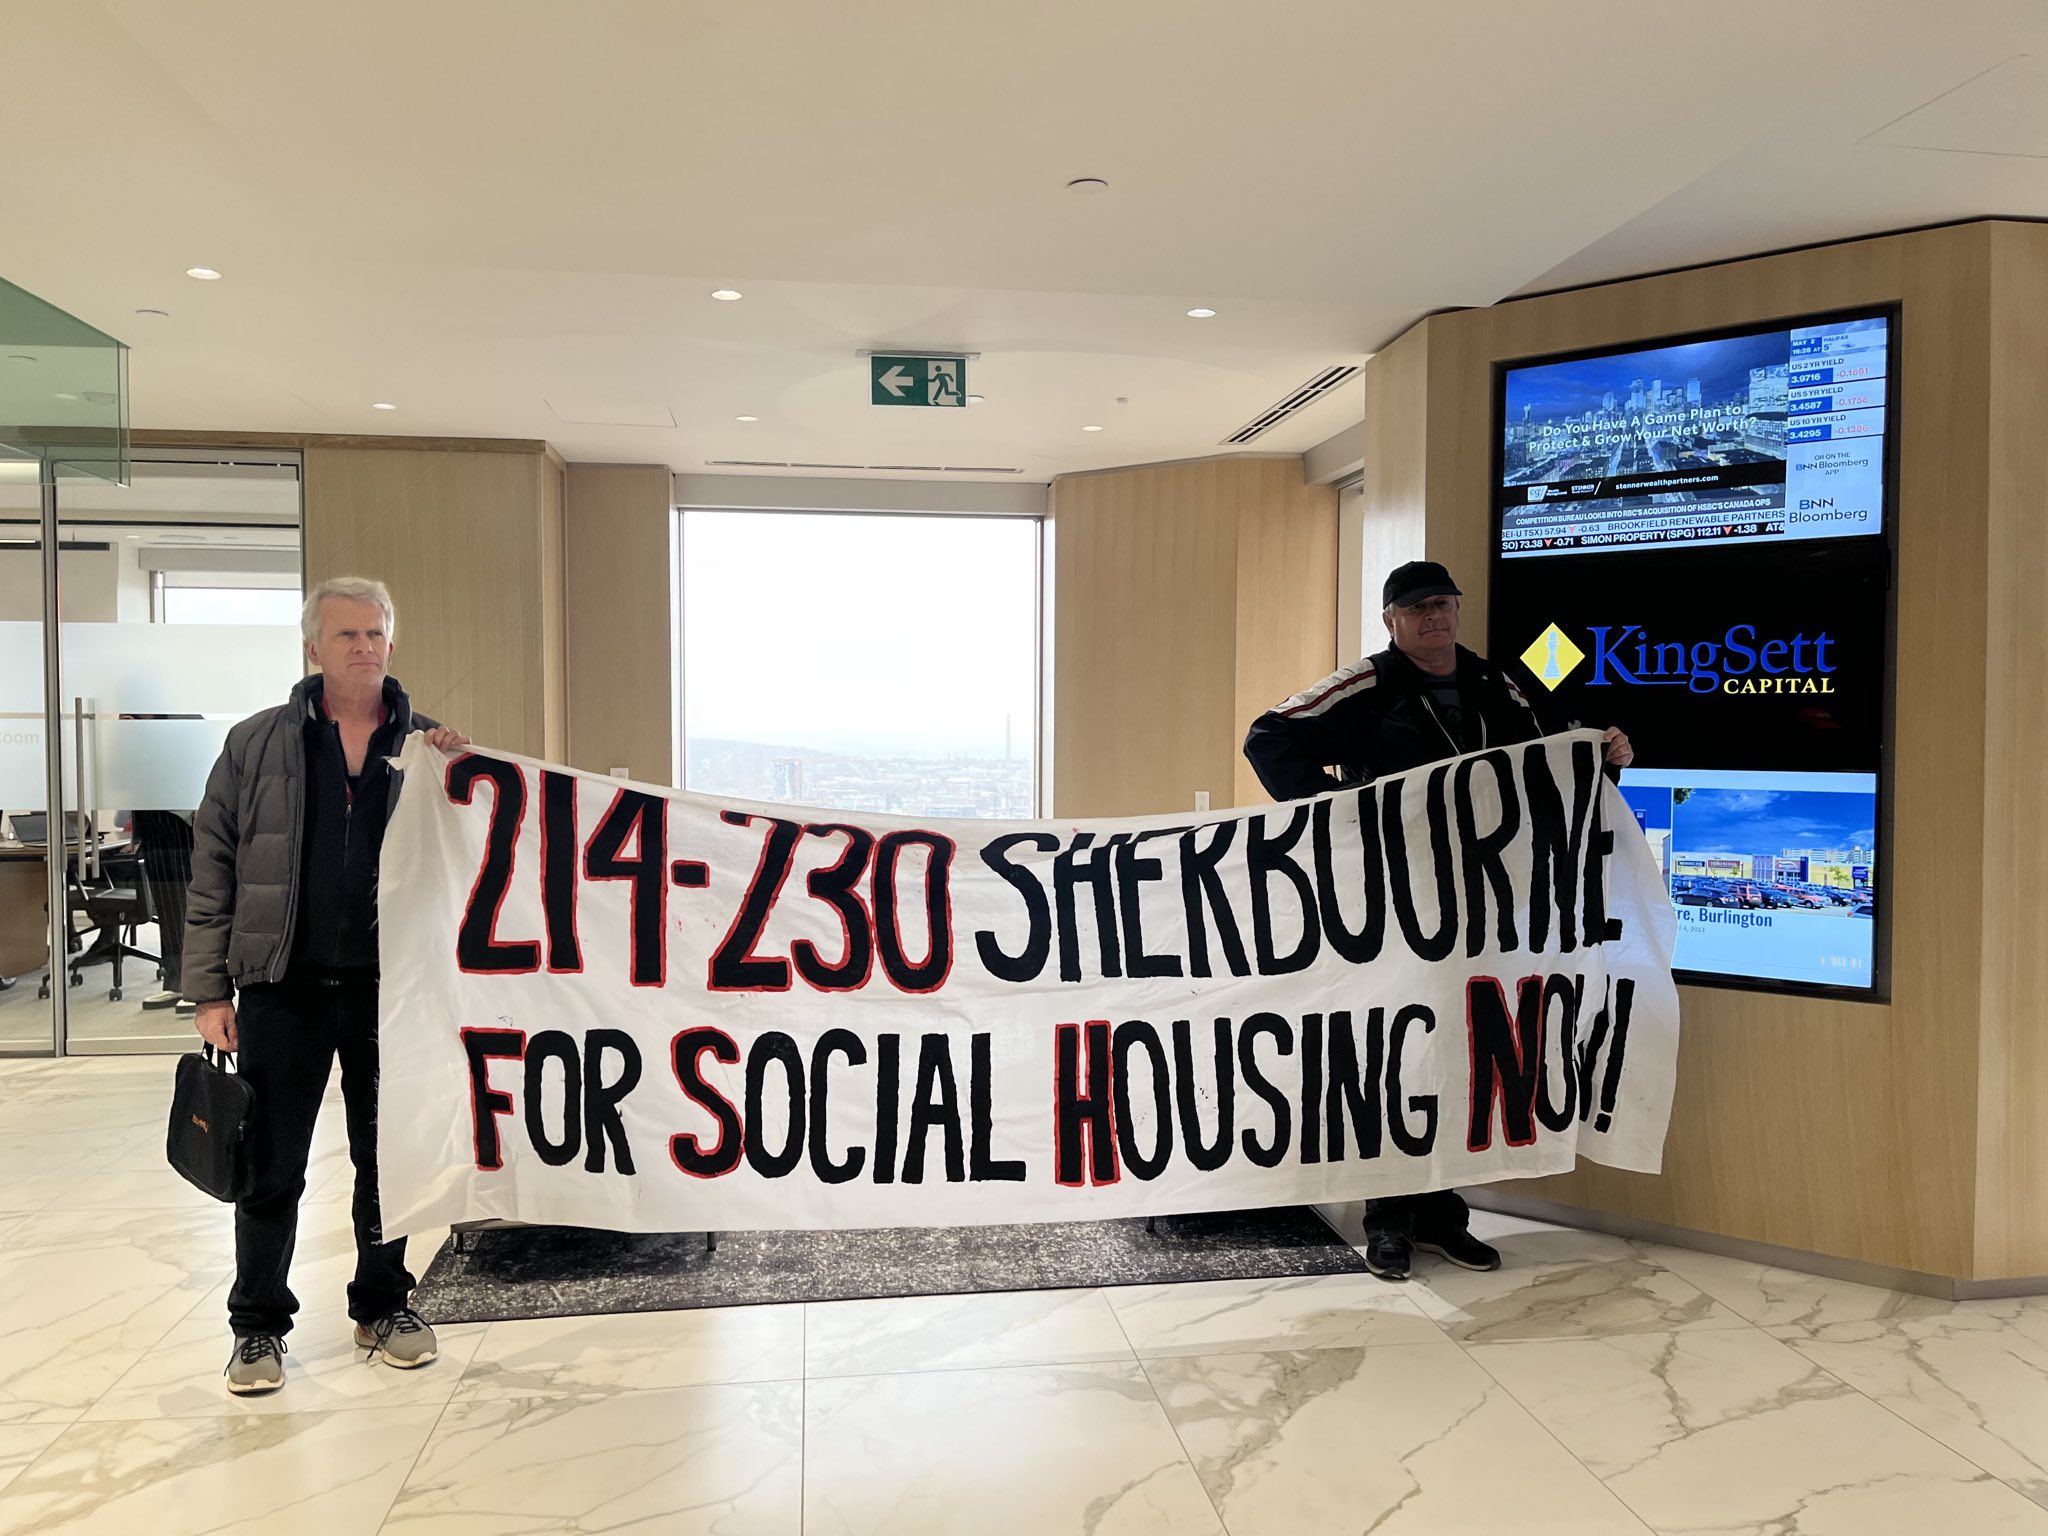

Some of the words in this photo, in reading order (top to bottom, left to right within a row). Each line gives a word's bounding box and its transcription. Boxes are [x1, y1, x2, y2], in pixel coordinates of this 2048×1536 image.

[1822, 358, 1844, 366] YIELD
[1791, 373, 1820, 383] 3.9716
[1790, 401, 1822, 411] 3.4587
[1543, 426, 1561, 437] Do
[1565, 423, 1589, 434] You
[1593, 419, 1627, 431] Have
[1630, 416, 1640, 427] A
[1644, 412, 1686, 425] Game
[1690, 408, 1721, 420] Plan
[1726, 405, 1741, 416] to
[1530, 437, 1578, 452] Protect
[1582, 436, 1591, 447] &
[1594, 433, 1631, 445] Grow
[1635, 429, 1668, 440] Your
[1671, 425, 1700, 437] Net
[1702, 416, 1757, 433] Worth?
[1790, 429, 1821, 439] 3.4295
[1818, 459, 1868, 468] Bloomberg
[1616, 475, 1718, 490] stennerwealthpartners.com
[1516, 515, 1557, 525] COMPETITION
[1558, 514, 1584, 522] BUREAU
[1585, 512, 1606, 520] LOOKS
[1624, 508, 1643, 516] RBC'S
[1644, 505, 1686, 515] ACQUISITION
[1698, 502, 1723, 510] HSBC'S
[1724, 500, 1754, 509] CANADA
[1755, 498, 1770, 506] OPS
[1800, 498, 1834, 510] BNN
[1524, 528, 1543, 537] TSX)
[1544, 527, 1566, 536] 57.94
[1578, 525, 1600, 533] -0.63
[1608, 519, 1668, 530] BROOKFIELD
[1670, 515, 1729, 526] RENEWABLE
[1732, 510, 1785, 521] PARTNERS
[1790, 509, 1868, 522] Bloomberg
[1502, 541, 1518, 550] SO)
[1519, 539, 1543, 548] 73.38
[1554, 538, 1574, 546] -0.71
[1581, 535, 1612, 544] SIMON
[1614, 530, 1666, 542] PROPERTY
[1666, 529, 1695, 540] (SPG)
[1697, 527, 1721, 536] 112.11
[1734, 524, 1758, 534] -1.38
[1585, 624, 1837, 693] KingSett
[1724, 678, 1835, 694] CAPITAL
[0, 732, 39, 744] oom
[444, 752, 956, 993] 214-230
[976, 741, 1623, 982] SHERBOURNE
[1675, 908, 1694, 922] re,
[1700, 908, 1772, 928] Burlington
[460, 1026, 642, 1175] FOR
[669, 1026, 1026, 1185] SOCIAL
[1054, 1004, 1438, 1187] HOUSING
